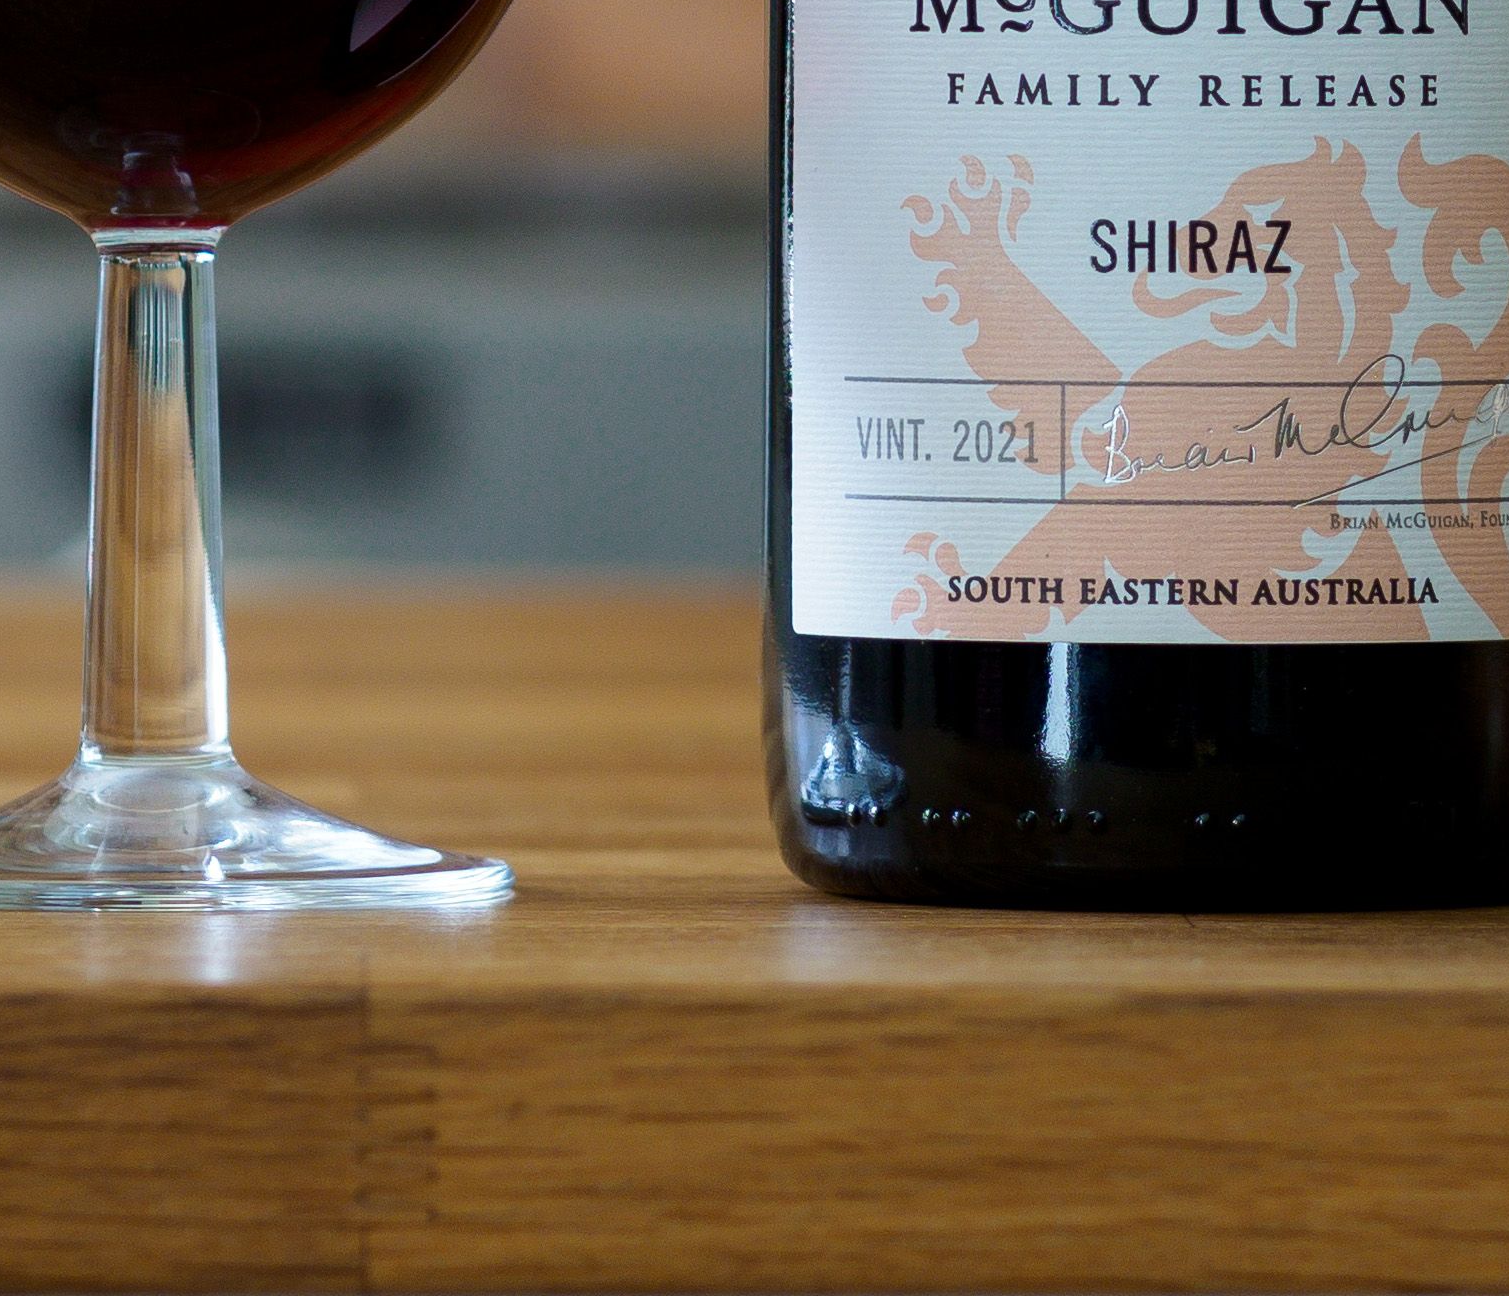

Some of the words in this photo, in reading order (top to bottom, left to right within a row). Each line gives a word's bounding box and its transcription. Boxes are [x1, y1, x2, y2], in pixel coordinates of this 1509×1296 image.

[947, 72, 1161, 107] FAMILY
[1198, 73, 1440, 107] RELEASE
[1089, 218, 1293, 275] SHIRAZ
[856, 415, 933, 463] VINT.
[953, 420, 1040, 465] 2021
[947, 575, 1065, 606] SOUTH
[1079, 578, 1240, 607] EASTERN
[1251, 577, 1440, 607] AUSTRALIA
